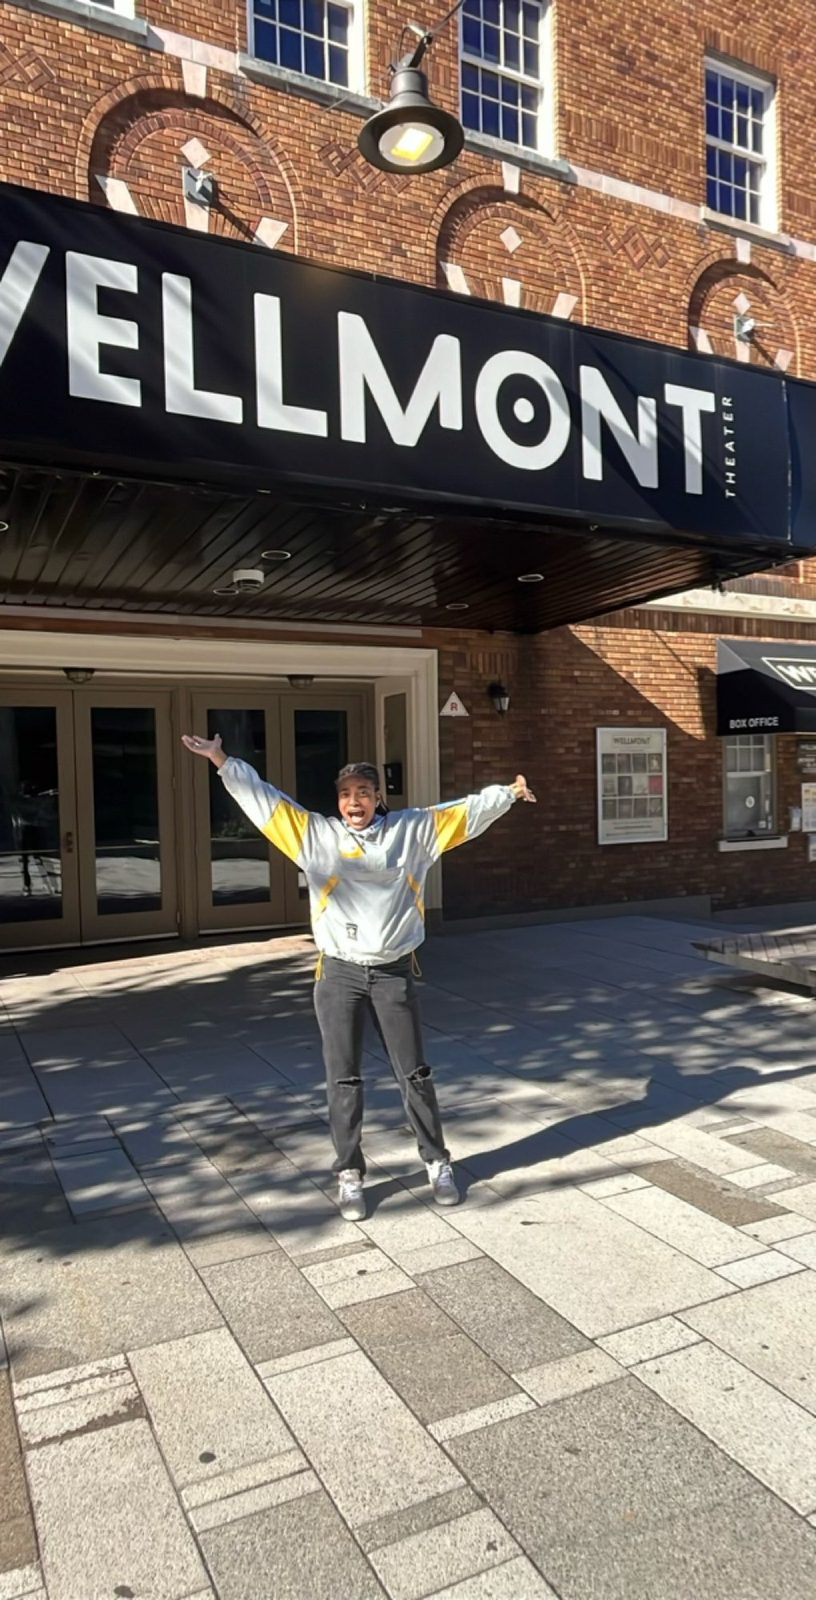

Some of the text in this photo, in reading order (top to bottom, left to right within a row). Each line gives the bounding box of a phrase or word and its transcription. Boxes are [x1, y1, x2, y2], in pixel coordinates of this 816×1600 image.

[0, 241, 716, 495] ELLMONT
[721, 397, 736, 498] THEATER
[450, 702, 458, 711] R
[729, 717, 779, 729] BOX OFFICE
